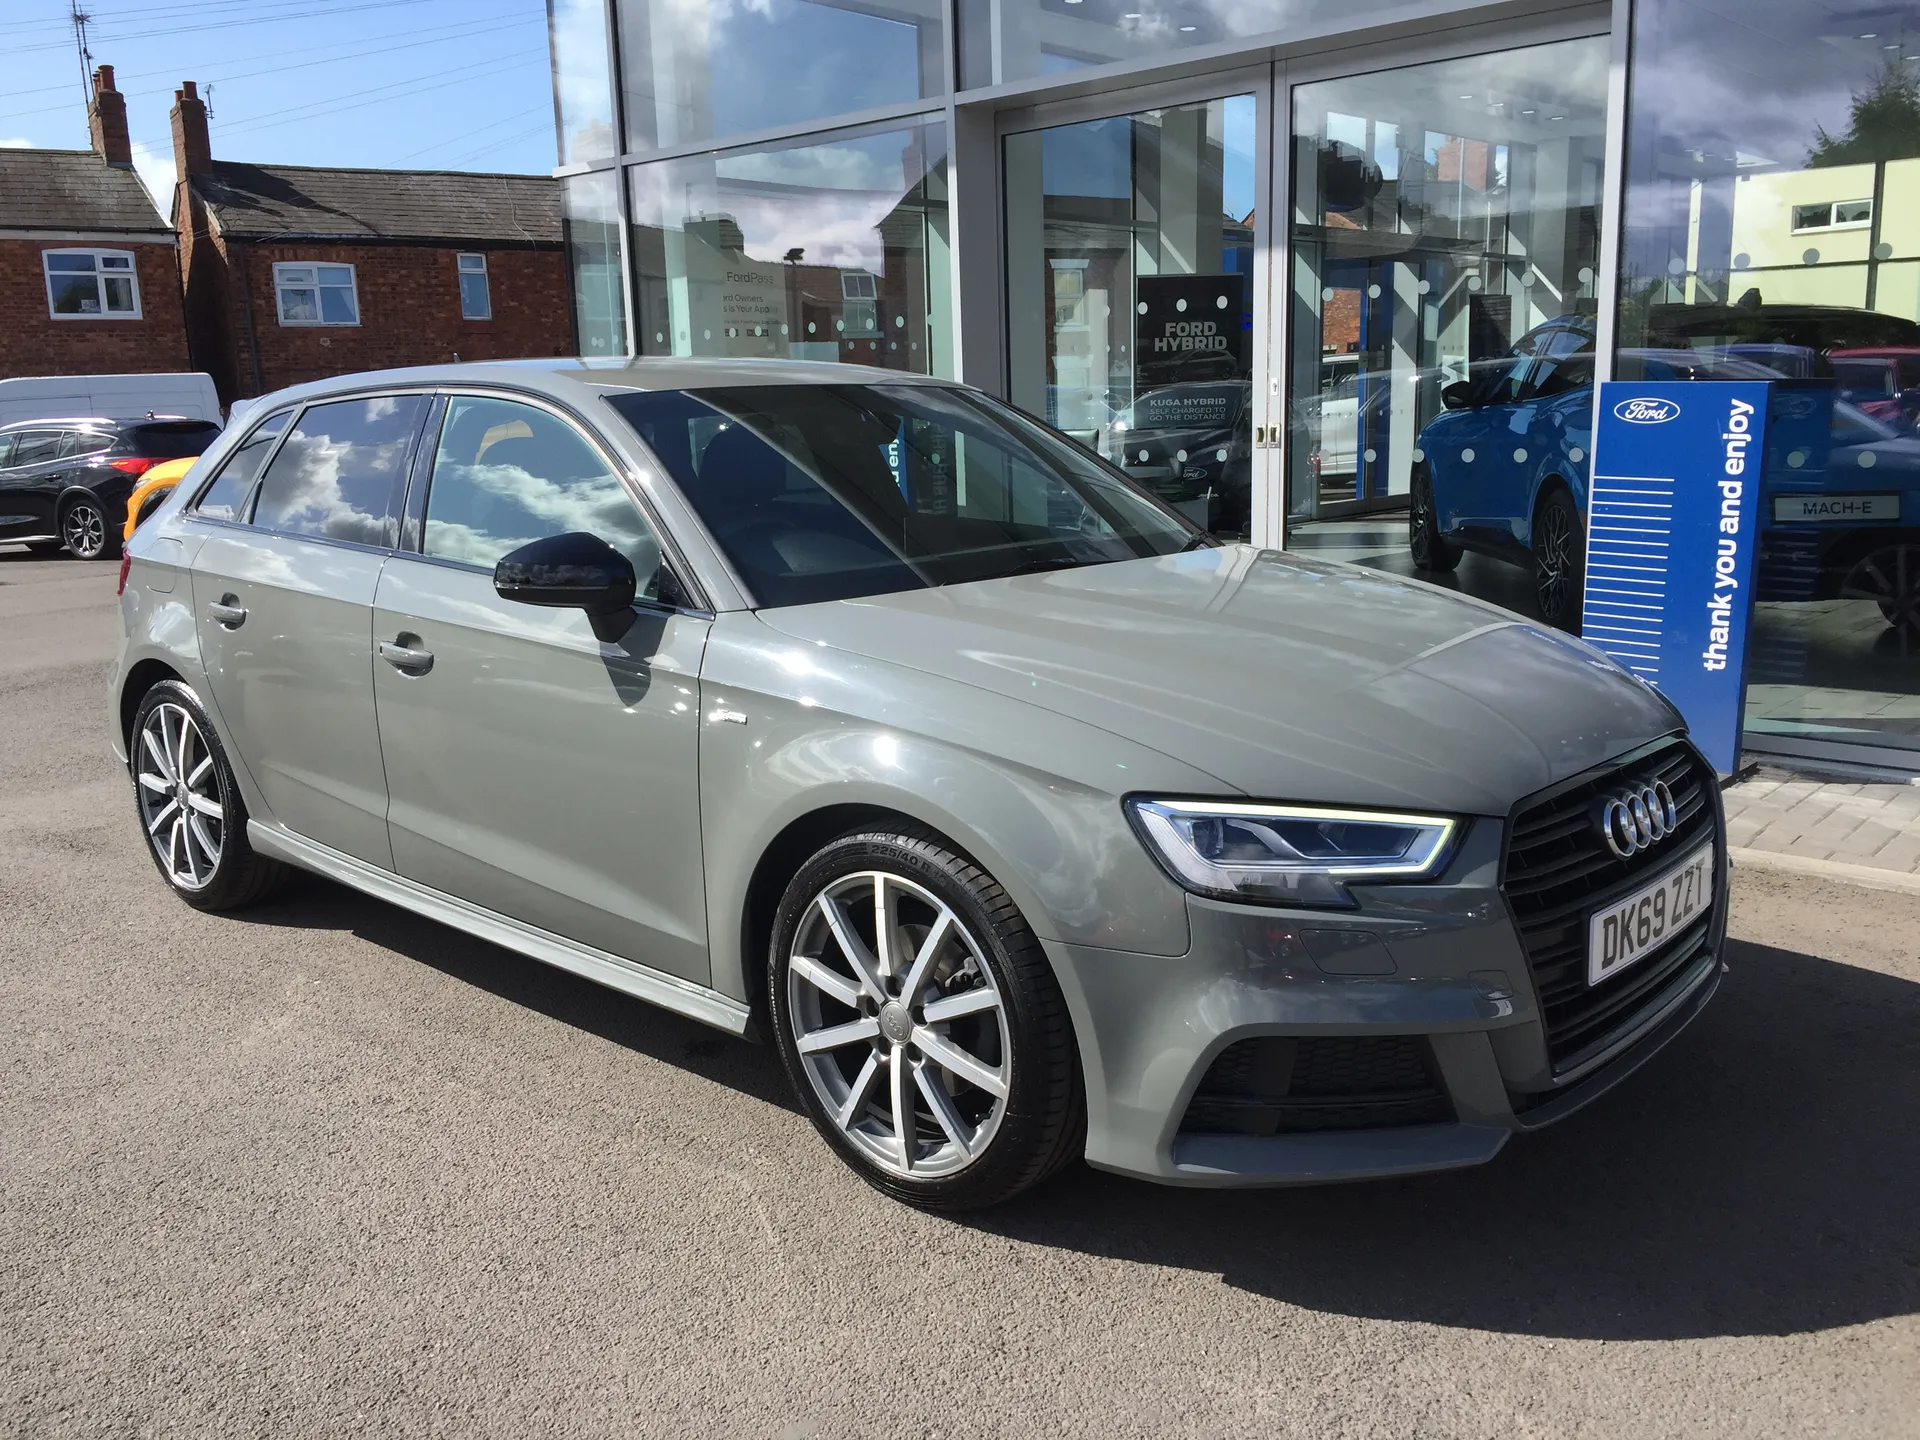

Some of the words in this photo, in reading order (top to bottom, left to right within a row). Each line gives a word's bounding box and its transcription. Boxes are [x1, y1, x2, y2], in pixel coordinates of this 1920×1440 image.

[726, 271, 774, 284] FordPass
[734, 293, 764, 302] Owners
[736, 304, 753, 313] Your
[1165, 321, 1217, 336] FORD
[1154, 336, 1228, 352] HYBRID
[1150, 399, 1182, 407] KUGA
[1183, 398, 1226, 406] HYBRID
[1623, 400, 1671, 421] Ford
[1149, 407, 1170, 415] SELF
[1722, 398, 1755, 476] enjoy
[1717, 480, 1743, 535] and
[1803, 501, 1873, 515] MACH-E
[1714, 538, 1739, 589] you
[1702, 593, 1733, 672] thank
[871, 844, 919, 866] 225/40
[1601, 887, 1667, 970] DK69
[1671, 856, 1706, 927] ZZT
